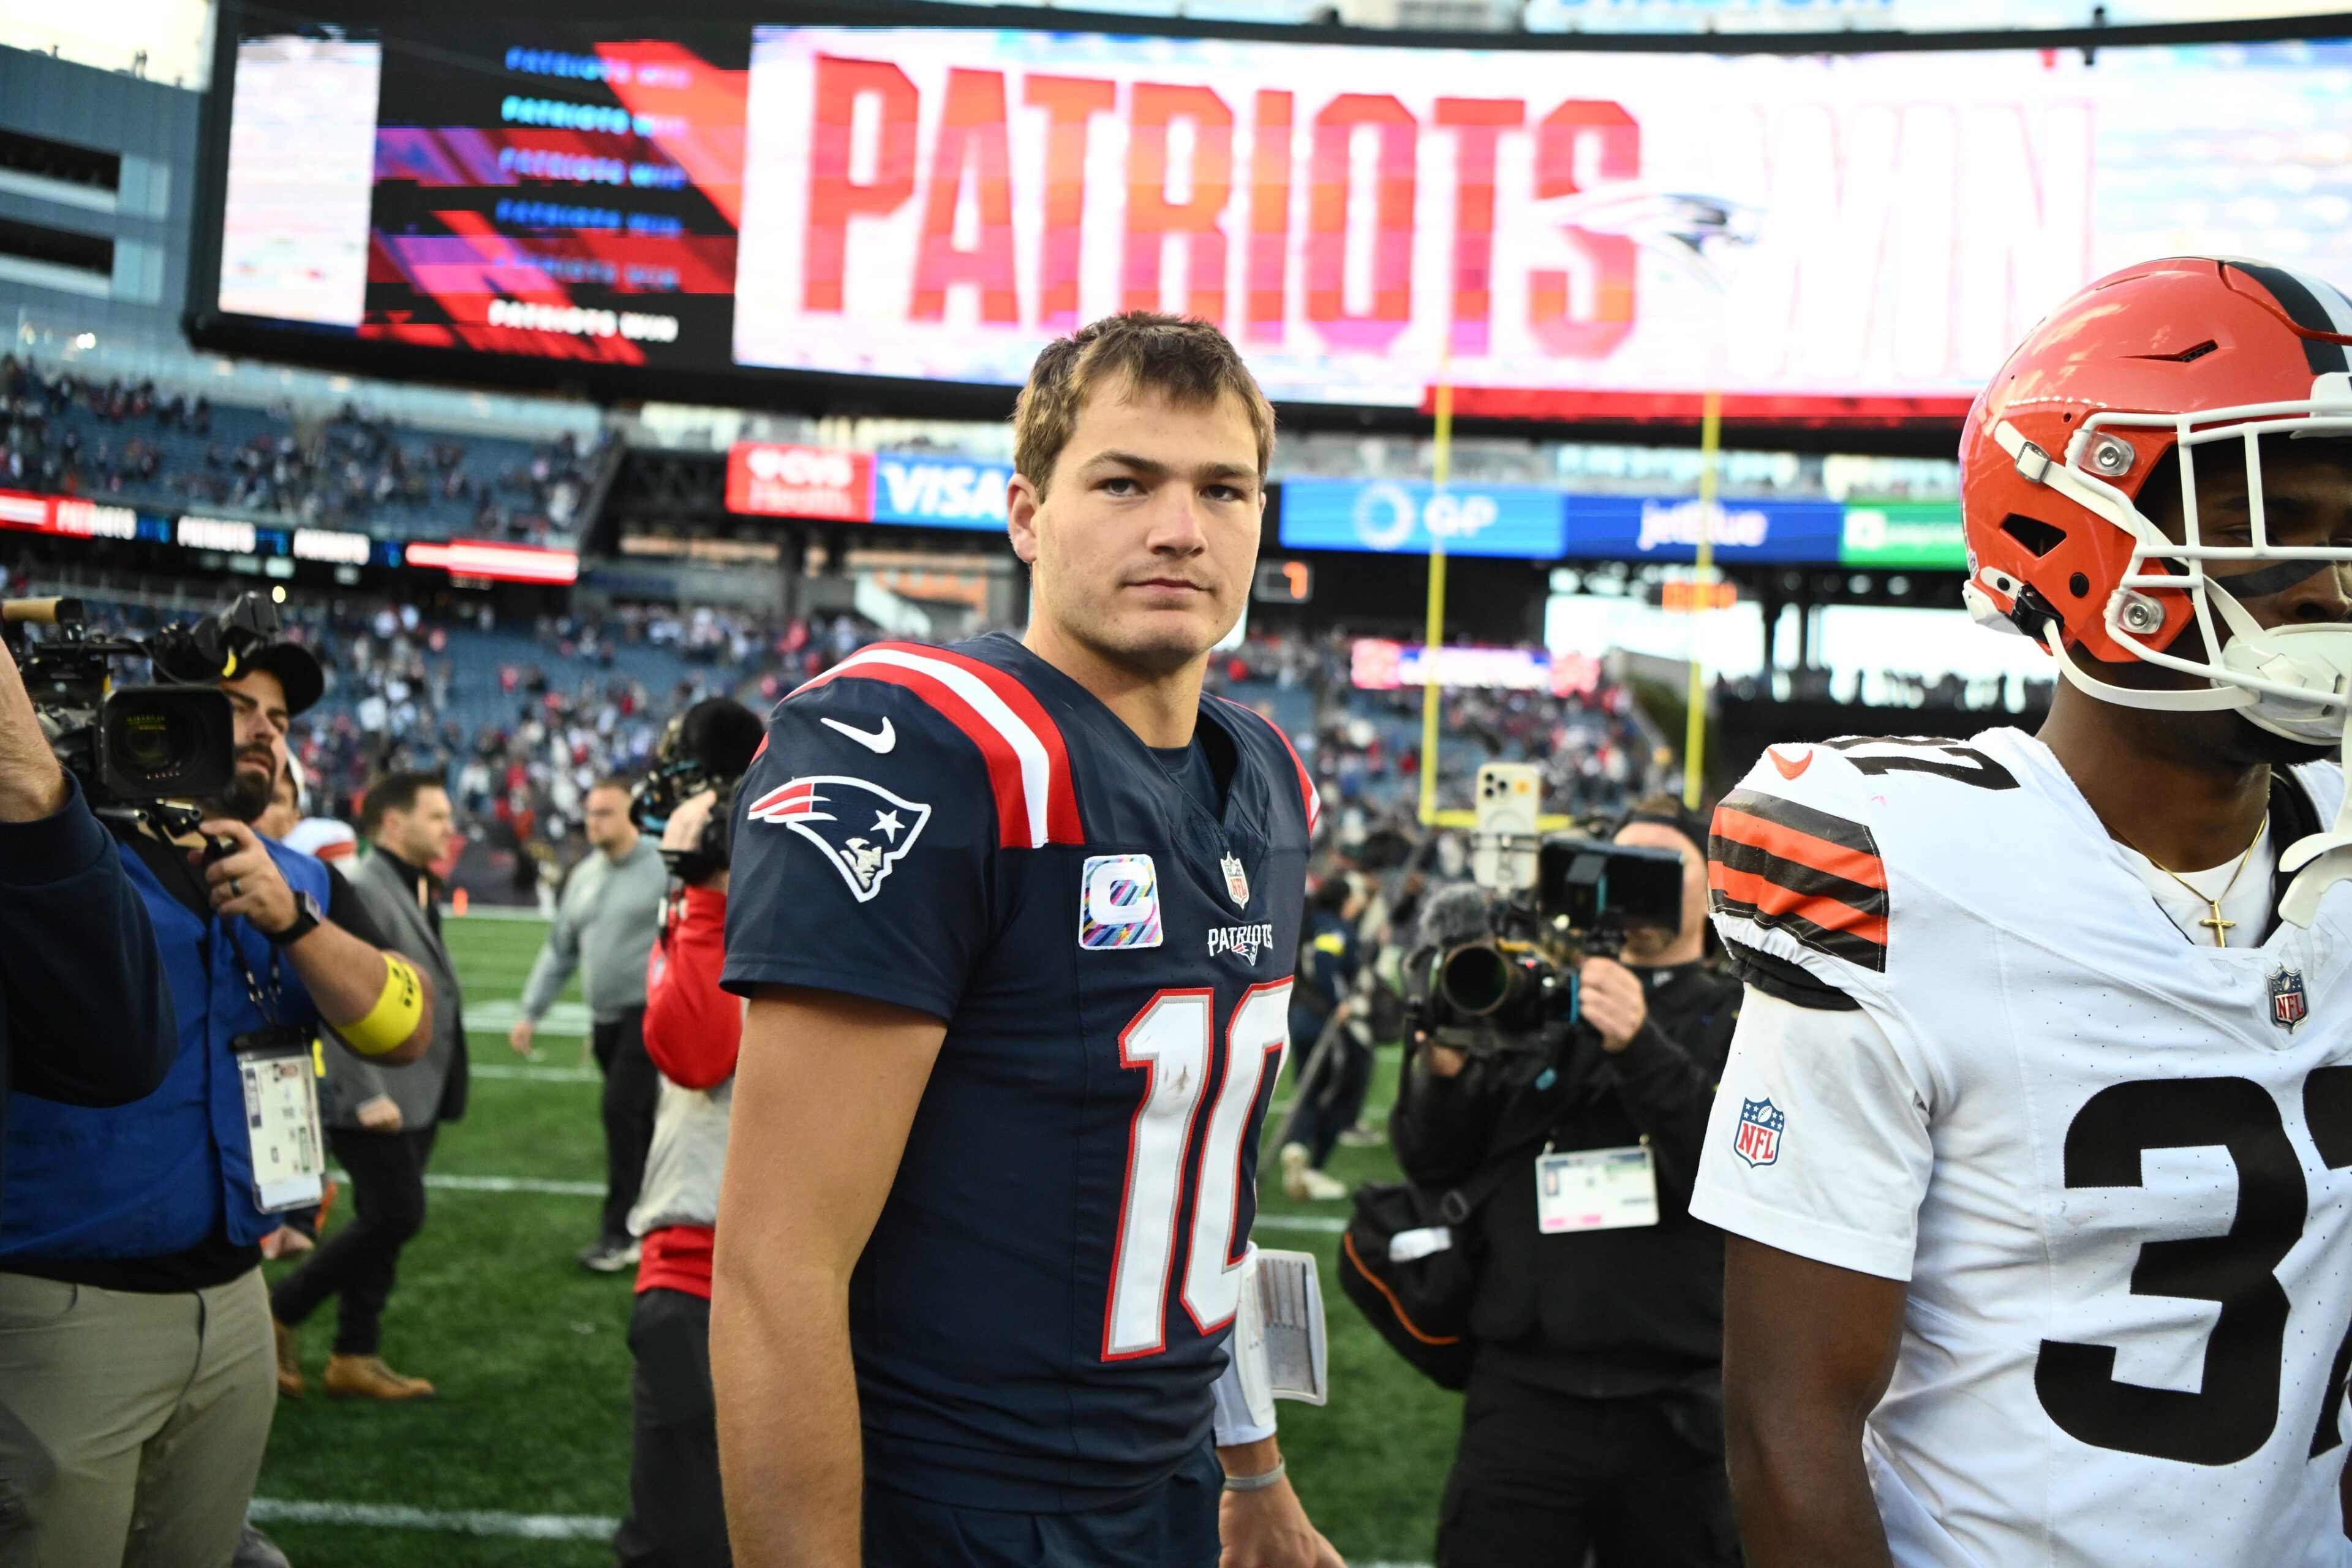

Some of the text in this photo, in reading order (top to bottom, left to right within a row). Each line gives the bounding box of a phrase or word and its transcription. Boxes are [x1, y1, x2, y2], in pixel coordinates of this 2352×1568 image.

[801, 53, 1640, 360] PATRIOTS
[880, 462, 1009, 521] VISA
[1090, 862, 1153, 924] C
[1229, 876, 1247, 898] NFL
[1207, 924, 1273, 957] PATRIOTS
[2277, 995, 2304, 1020] NFL
[1738, 1123, 1774, 1160] NFL
[1102, 975, 1294, 1362] 10
